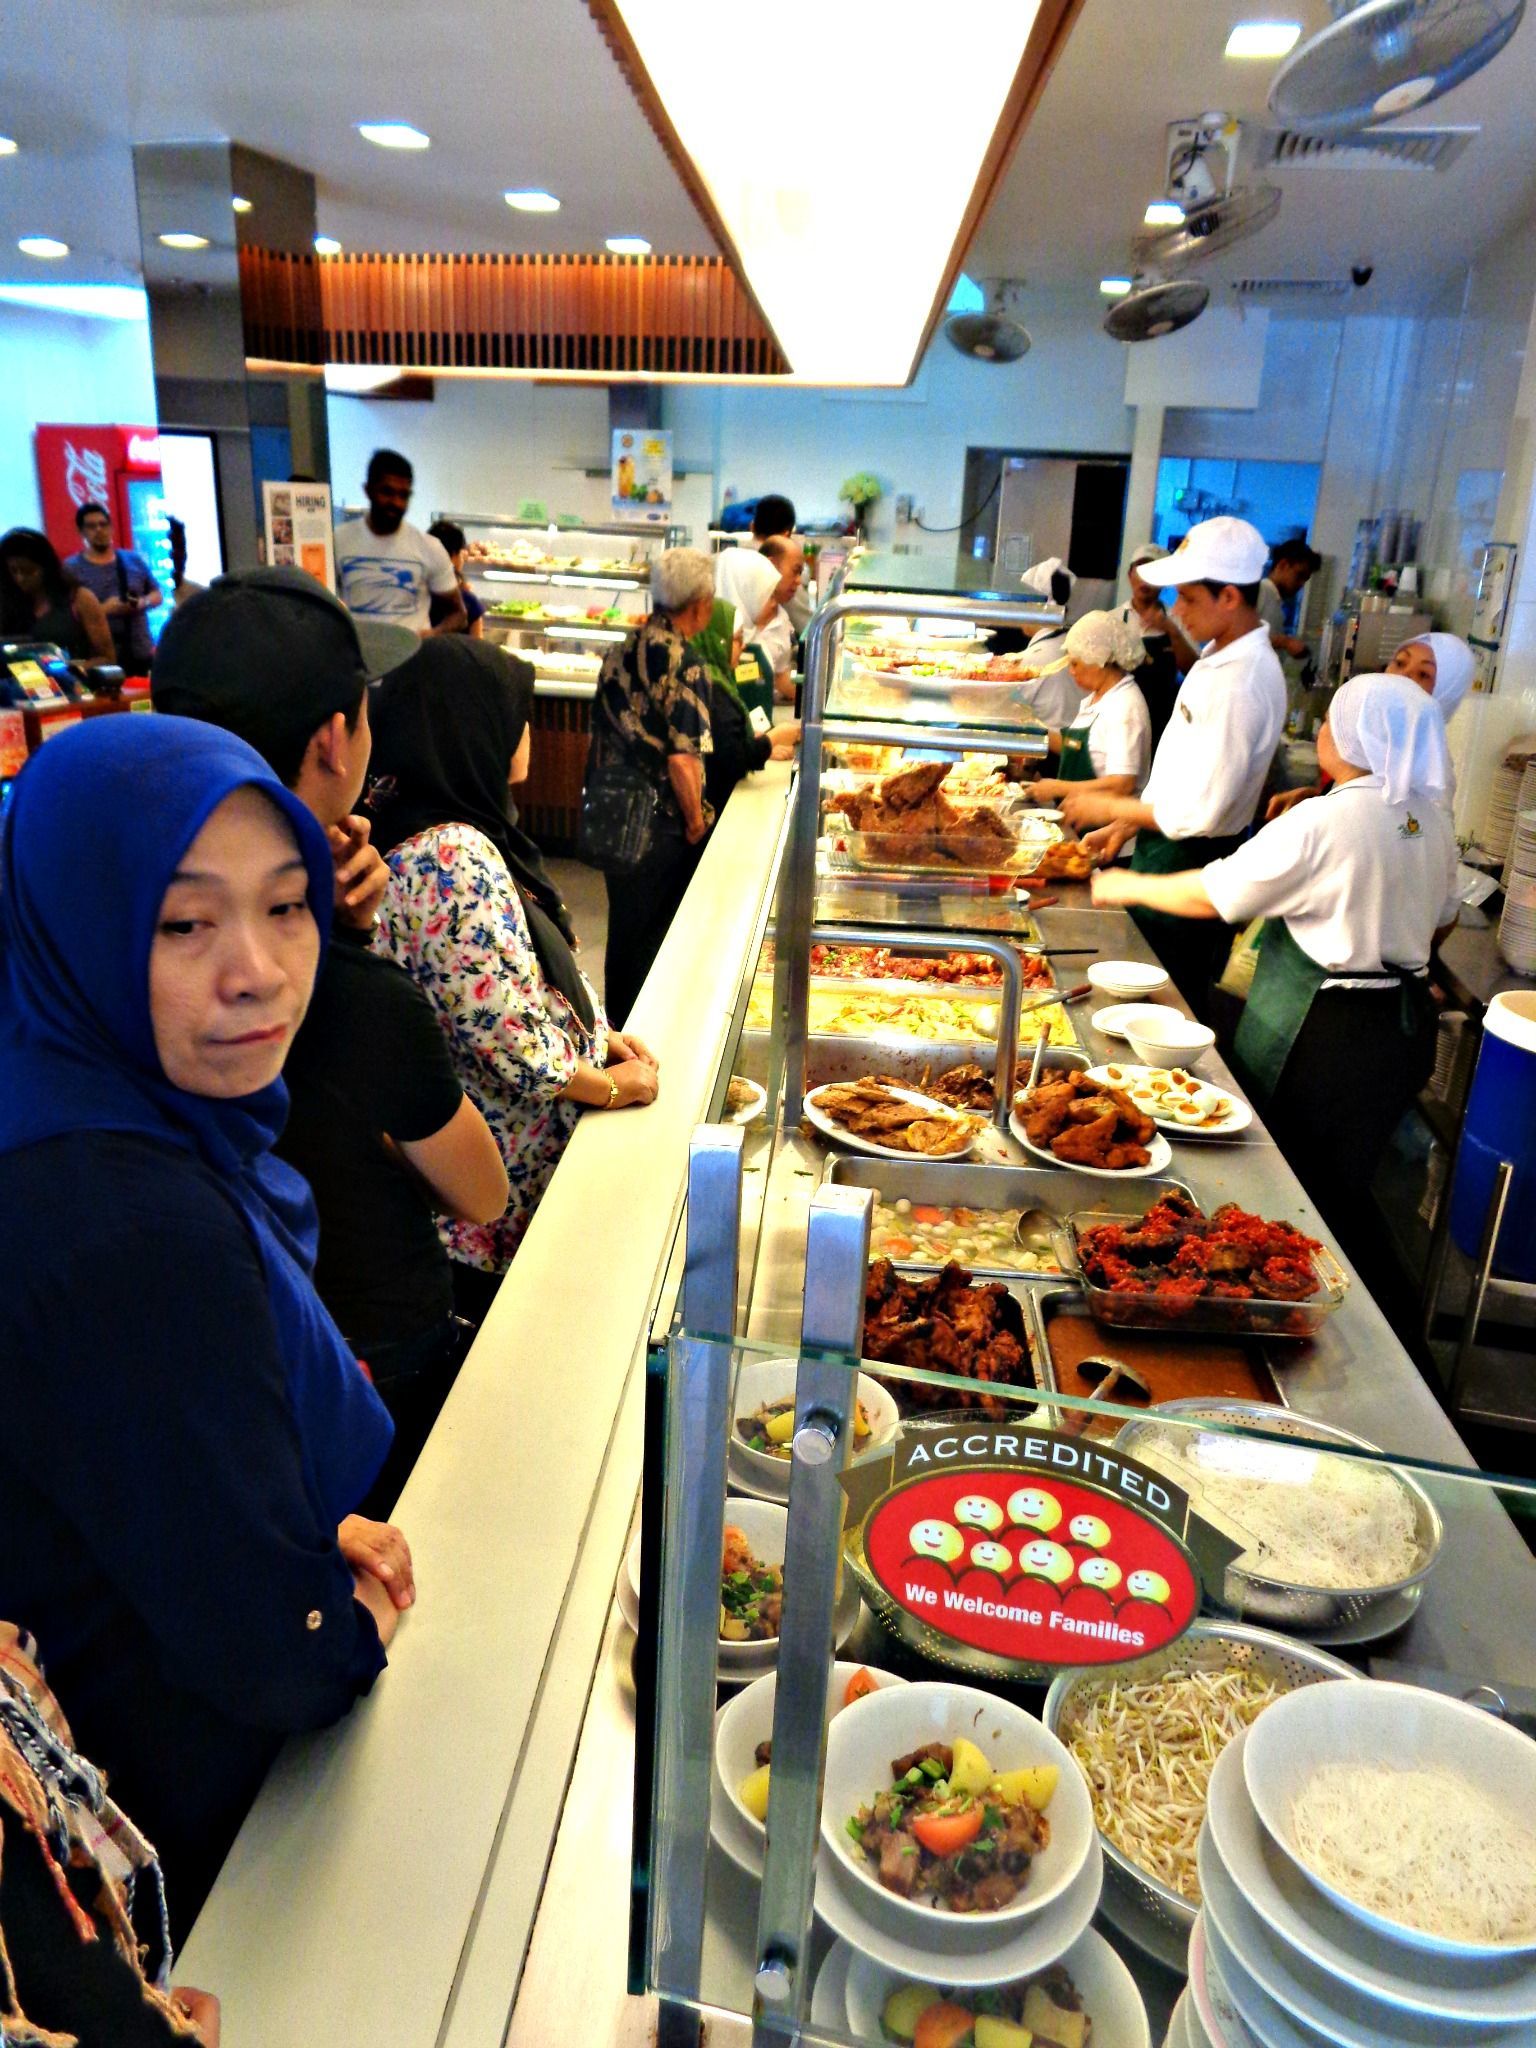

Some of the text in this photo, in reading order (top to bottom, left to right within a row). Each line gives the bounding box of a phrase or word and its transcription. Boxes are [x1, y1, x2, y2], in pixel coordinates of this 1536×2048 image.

[295, 495, 326, 508] HIRING
[906, 1434, 1172, 1511] ACCREDITED
[905, 1582, 1145, 1647] We Welcome Families
